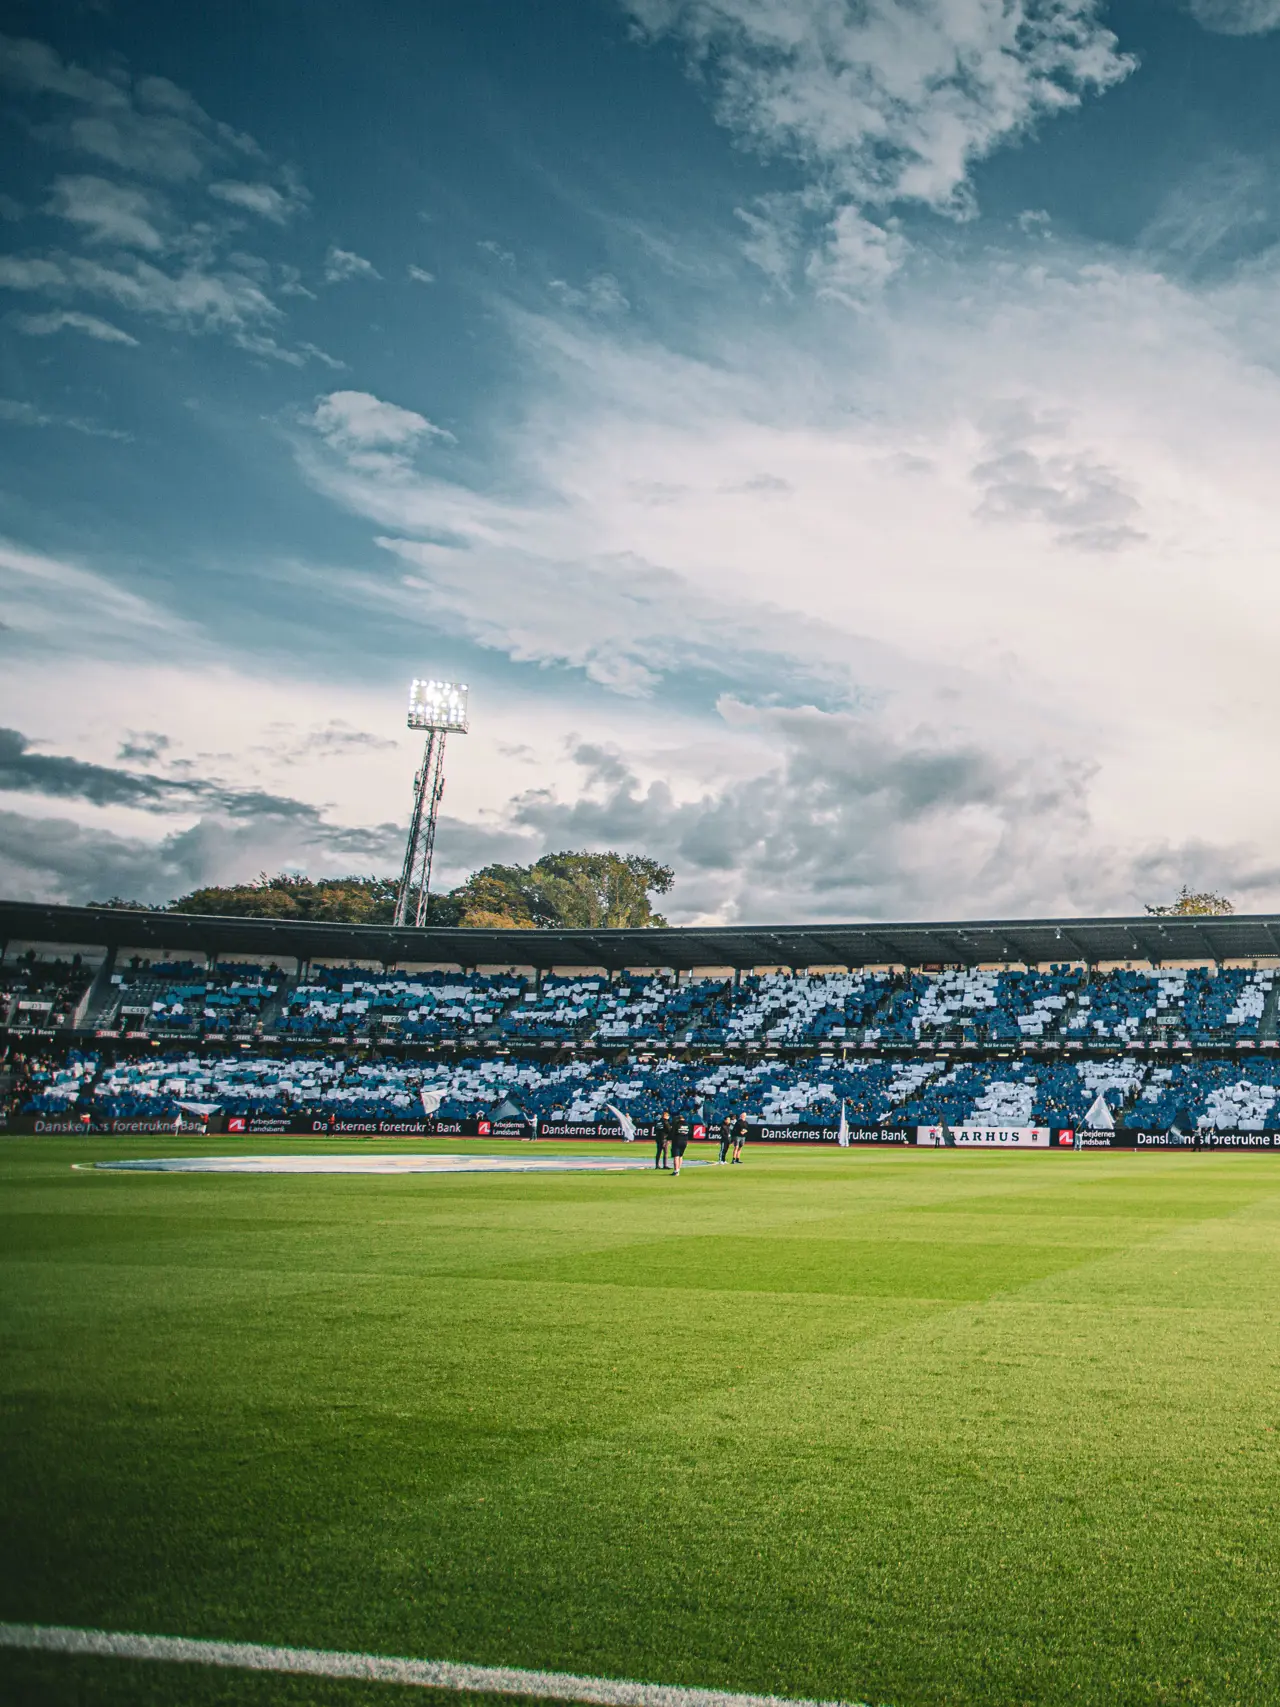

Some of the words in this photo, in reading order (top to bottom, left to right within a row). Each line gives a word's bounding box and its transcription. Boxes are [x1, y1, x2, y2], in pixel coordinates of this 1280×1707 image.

[249, 1118, 291, 1127] Arbejdernes
[436, 1122, 462, 1133] Bank
[541, 1124, 596, 1136] Danskernes
[761, 1127, 820, 1140] Danskernes
[881, 1129, 908, 1142] Bank
[1080, 1130, 1116, 1139] rbejdernes
